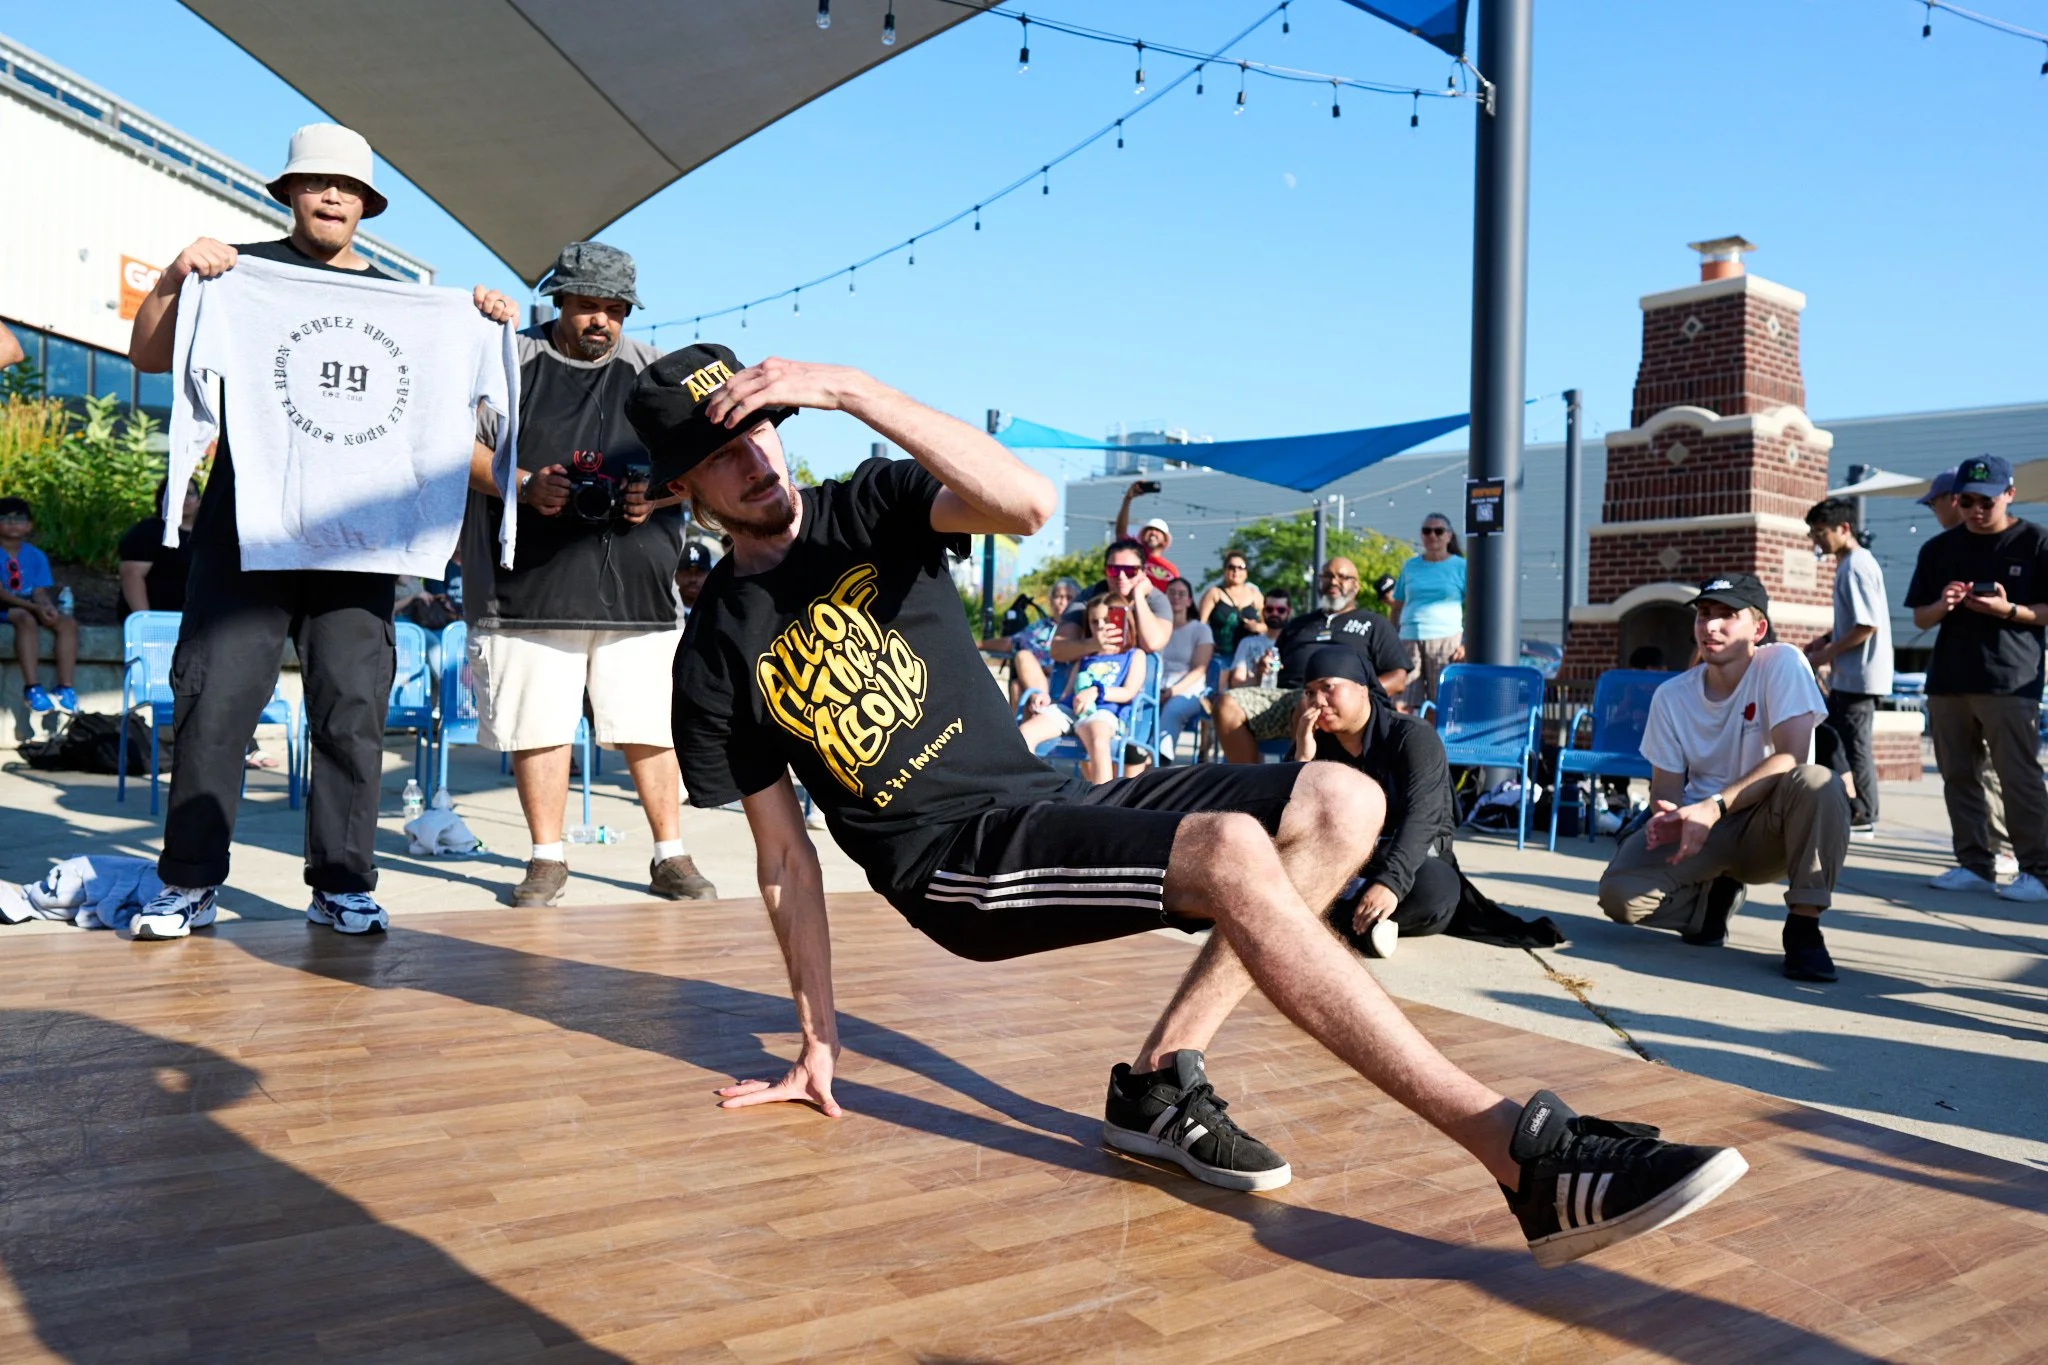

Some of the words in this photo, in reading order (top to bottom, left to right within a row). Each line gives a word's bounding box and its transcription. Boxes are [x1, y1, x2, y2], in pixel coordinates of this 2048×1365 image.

[318, 360, 370, 393] 99
[686, 360, 735, 402] AOTA
[1530, 1107, 1548, 1132] adidas
